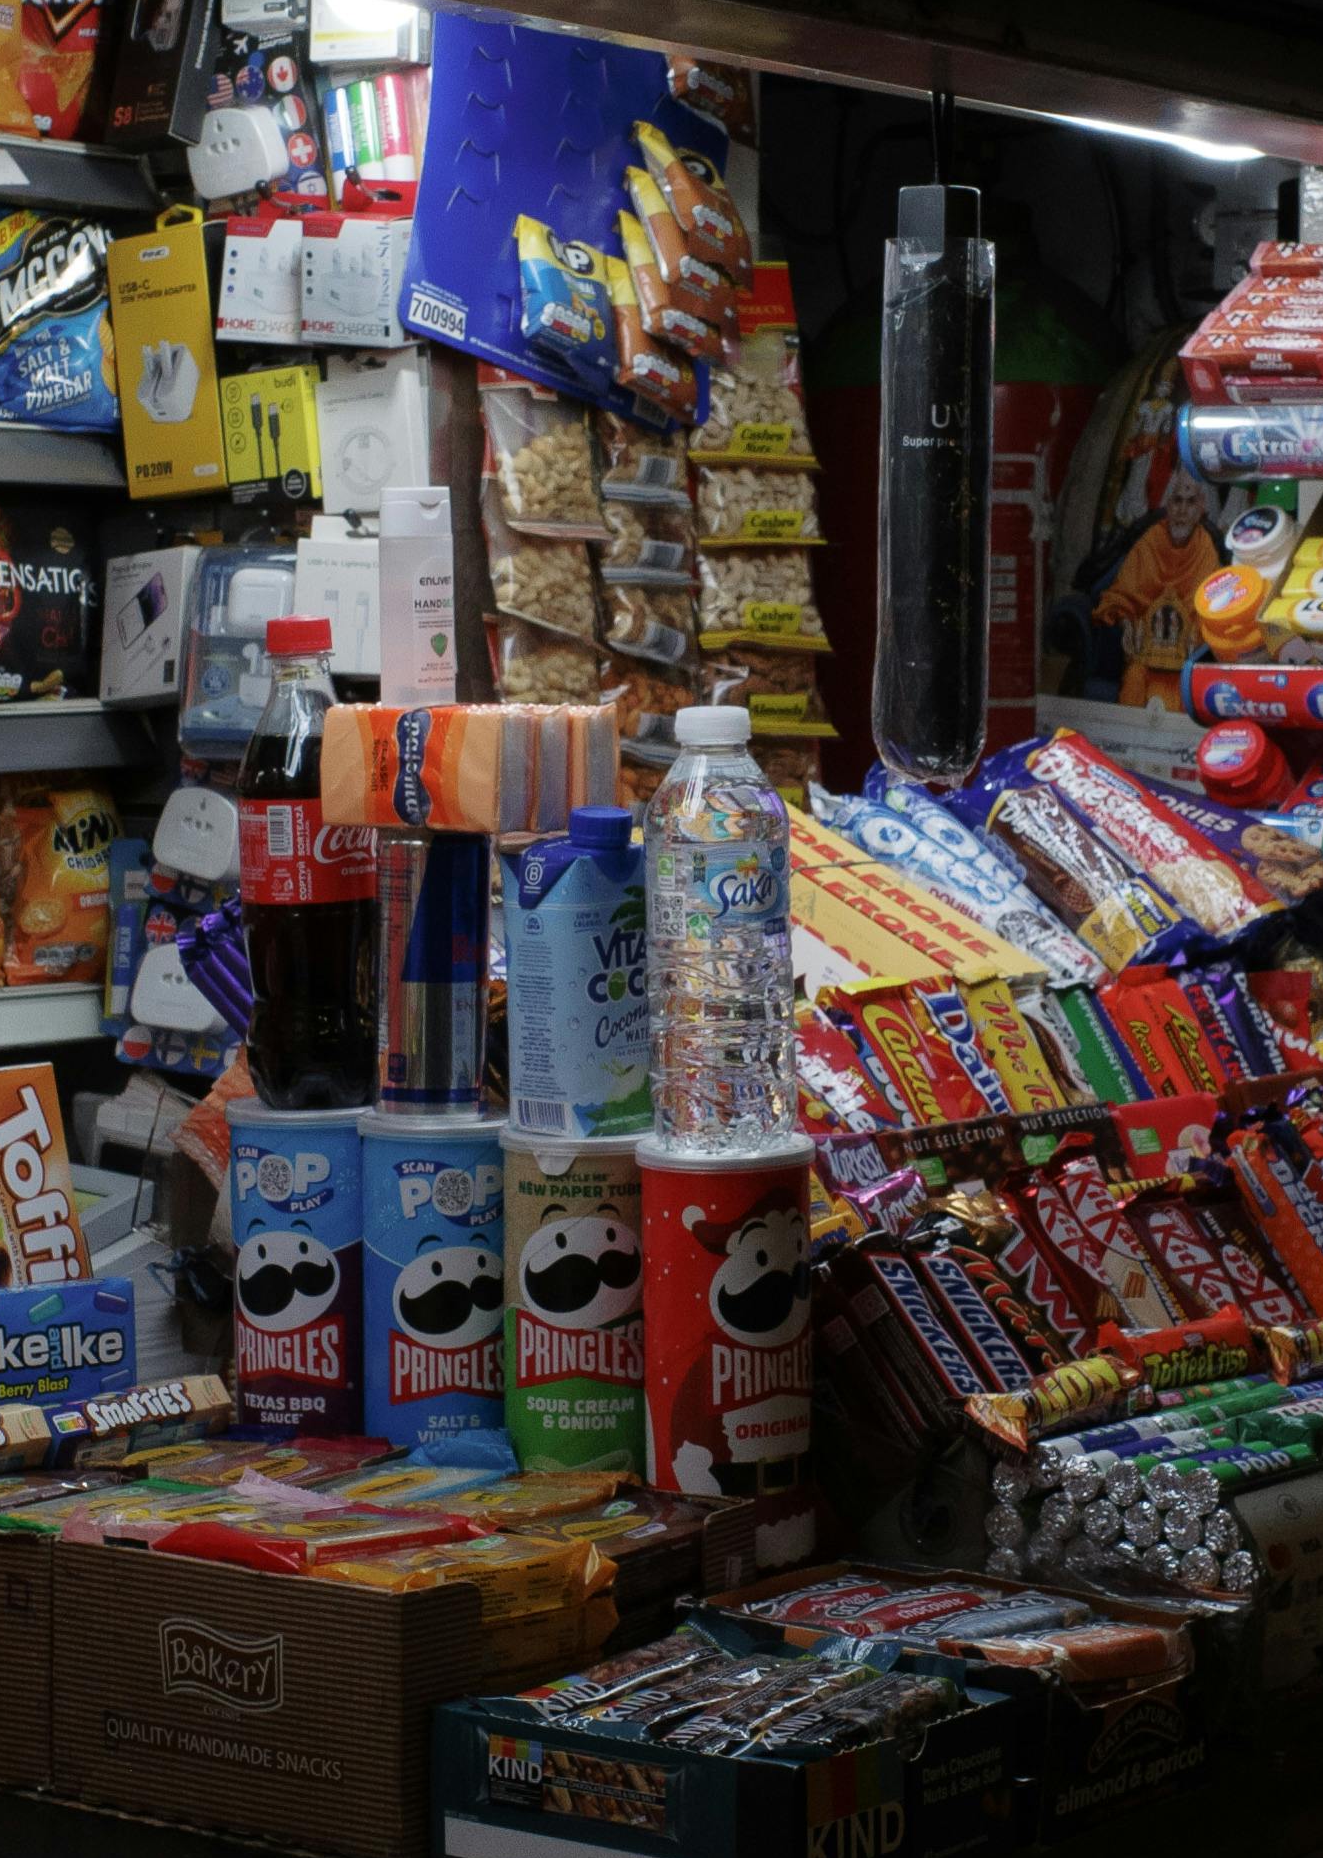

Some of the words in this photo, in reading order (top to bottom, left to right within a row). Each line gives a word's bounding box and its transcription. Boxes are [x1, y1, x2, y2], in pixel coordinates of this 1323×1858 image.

[119, 279, 150, 292] USB-C
[412, 297, 465, 336] 700994
[931, 404, 968, 429] UV
[741, 427, 784, 443] Cashew
[902, 433, 934, 451] Super
[749, 514, 796, 530] Cashew
[750, 606, 796, 622] Cashew
[1214, 691, 1288, 718] Extra
[929, 887, 984, 924] DOUBLE
[1020, 1114, 1047, 1132] NUT
[1048, 1105, 1110, 1127] SELECTION
[903, 1135, 932, 1153] NUT
[936, 1124, 1007, 1149] SELECTION
[237, 1145, 259, 1159] SCAN
[401, 1162, 436, 1175] SCAN
[519, 1180, 546, 1196] NEW
[549, 1182, 602, 1199] PAPER
[290, 1193, 327, 1213] PLAY
[469, 1208, 502, 1227] PLAY
[1202, 1209, 1226, 1239] DARK
[954, 1247, 1064, 1368] Mars
[877, 1258, 985, 1396] SNICKERS
[925, 1257, 1033, 1393] SNICKERS
[48, 1324, 65, 1372] and
[60, 1321, 124, 1370] Ike
[238, 1323, 340, 1382] PRINGLES
[520, 1317, 644, 1383] PRINGLES
[38, 1376, 70, 1394] Blast
[1034, 1356, 1124, 1427] LION
[244, 1393, 286, 1411] TEXAS
[288, 1396, 326, 1414] BBQ
[526, 1395, 569, 1415] SOUR
[573, 1396, 636, 1415] CREAM
[260, 1411, 300, 1426] SAUCE
[428, 1414, 461, 1429] SALT
[466, 1414, 481, 1428] &
[543, 1413, 556, 1430] &
[559, 1413, 617, 1431] ONION
[1234, 1451, 1292, 1477] POLO
[532, 1681, 606, 1720] KIND
[598, 1690, 673, 1724] KIND
[106, 1717, 174, 1749] QUALITY
[176, 1730, 273, 1770] HANDMADE
[275, 1751, 343, 1781] SNACKS
[488, 1755, 543, 1785] KIND
[1055, 1767, 1127, 1816] almond
[1143, 1738, 1206, 1786] apricot
